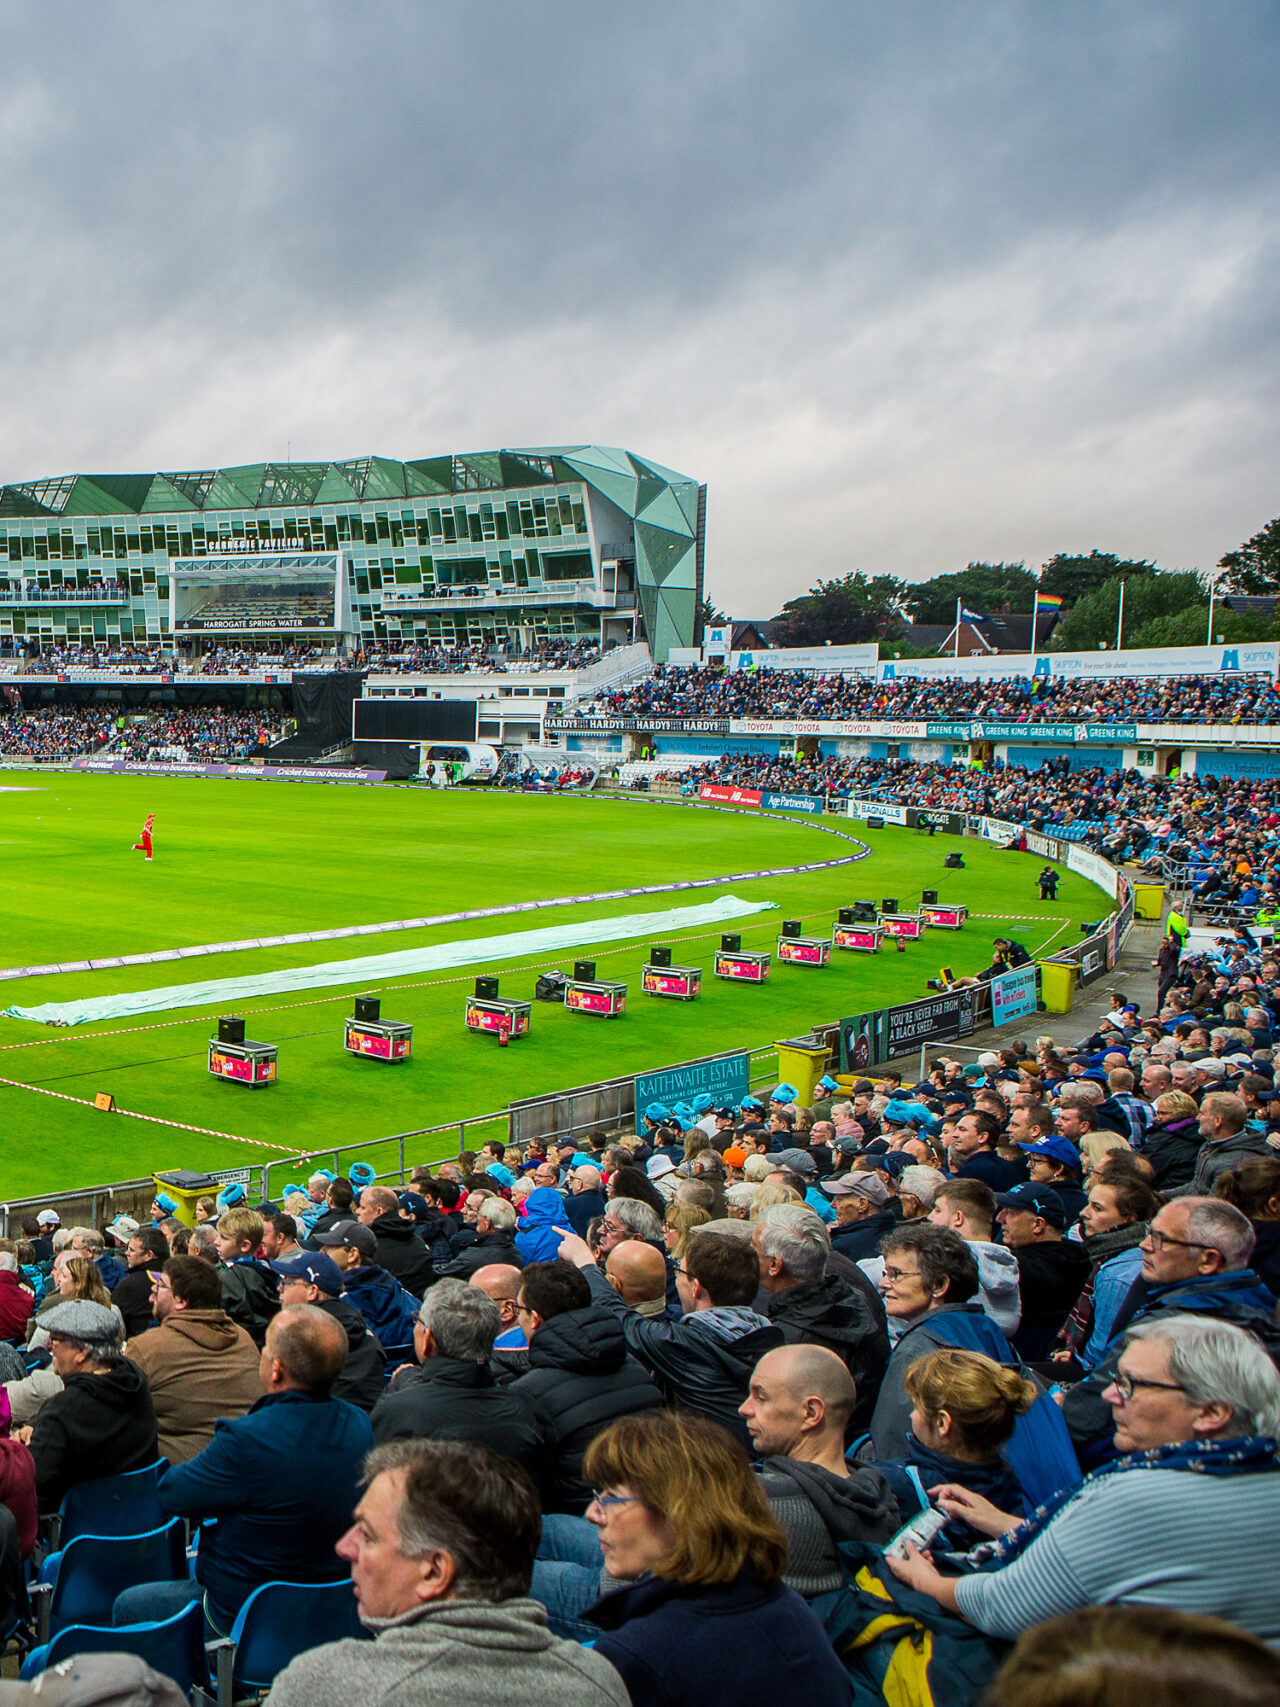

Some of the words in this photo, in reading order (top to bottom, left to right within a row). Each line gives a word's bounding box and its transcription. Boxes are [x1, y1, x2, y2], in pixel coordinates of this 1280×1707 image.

[208, 539, 256, 550] CARNEGIE
[259, 537, 304, 549] PAVILION
[203, 620, 247, 628] HARROGATE
[249, 620, 276, 628] SPRING
[278, 619, 303, 627] WATER
[1243, 651, 1275, 663] SKIPTON
[1054, 659, 1082, 669] SKIPTON
[544, 719, 577, 728] HARDYS
[590, 719, 624, 729] HARDYS
[636, 720, 670, 730] HARDYS
[683, 721, 718, 731] HARDYS
[794, 724, 820, 732] TOYOTA
[844, 725, 871, 733] TOYOTA
[892, 725, 919, 733] TOYOTA
[927, 726, 952, 734] GREENE
[954, 726, 970, 735] KING
[985, 727, 1010, 736] GREENE
[1011, 727, 1028, 736] KING
[1030, 727, 1055, 736] GREENE
[1057, 728, 1073, 737] KING
[1089, 728, 1116, 738] GREENE
[1117, 729, 1135, 738] KING
[87, 761, 114, 769] NatWest
[125, 762, 148, 770] Cricket
[148, 763, 160, 771] has
[169, 764, 207, 772] boundaries
[236, 766, 264, 775] NatWest
[276, 768, 301, 776] Cricket
[302, 769, 316, 777] has
[327, 770, 369, 779] boundaries
[768, 795, 781, 809] Age
[781, 796, 815, 813] Partnership
[861, 804, 901, 818] BAGNALLS
[889, 1010, 913, 1027] YOU'RE
[913, 1006, 931, 1022] NEVER
[932, 1002, 943, 1017] FAR
[943, 998, 959, 1014] FROM
[889, 1028, 895, 1042] A
[896, 1023, 916, 1040] BLACK
[639, 1066, 707, 1098] RAITHWAITE
[710, 1058, 745, 1082] ESTATE
[659, 1091, 686, 1102] YORKSHIRE
[687, 1086, 707, 1096] COASTAL
[708, 1081, 728, 1091] RETREAT
[723, 1092, 734, 1101] SPA
